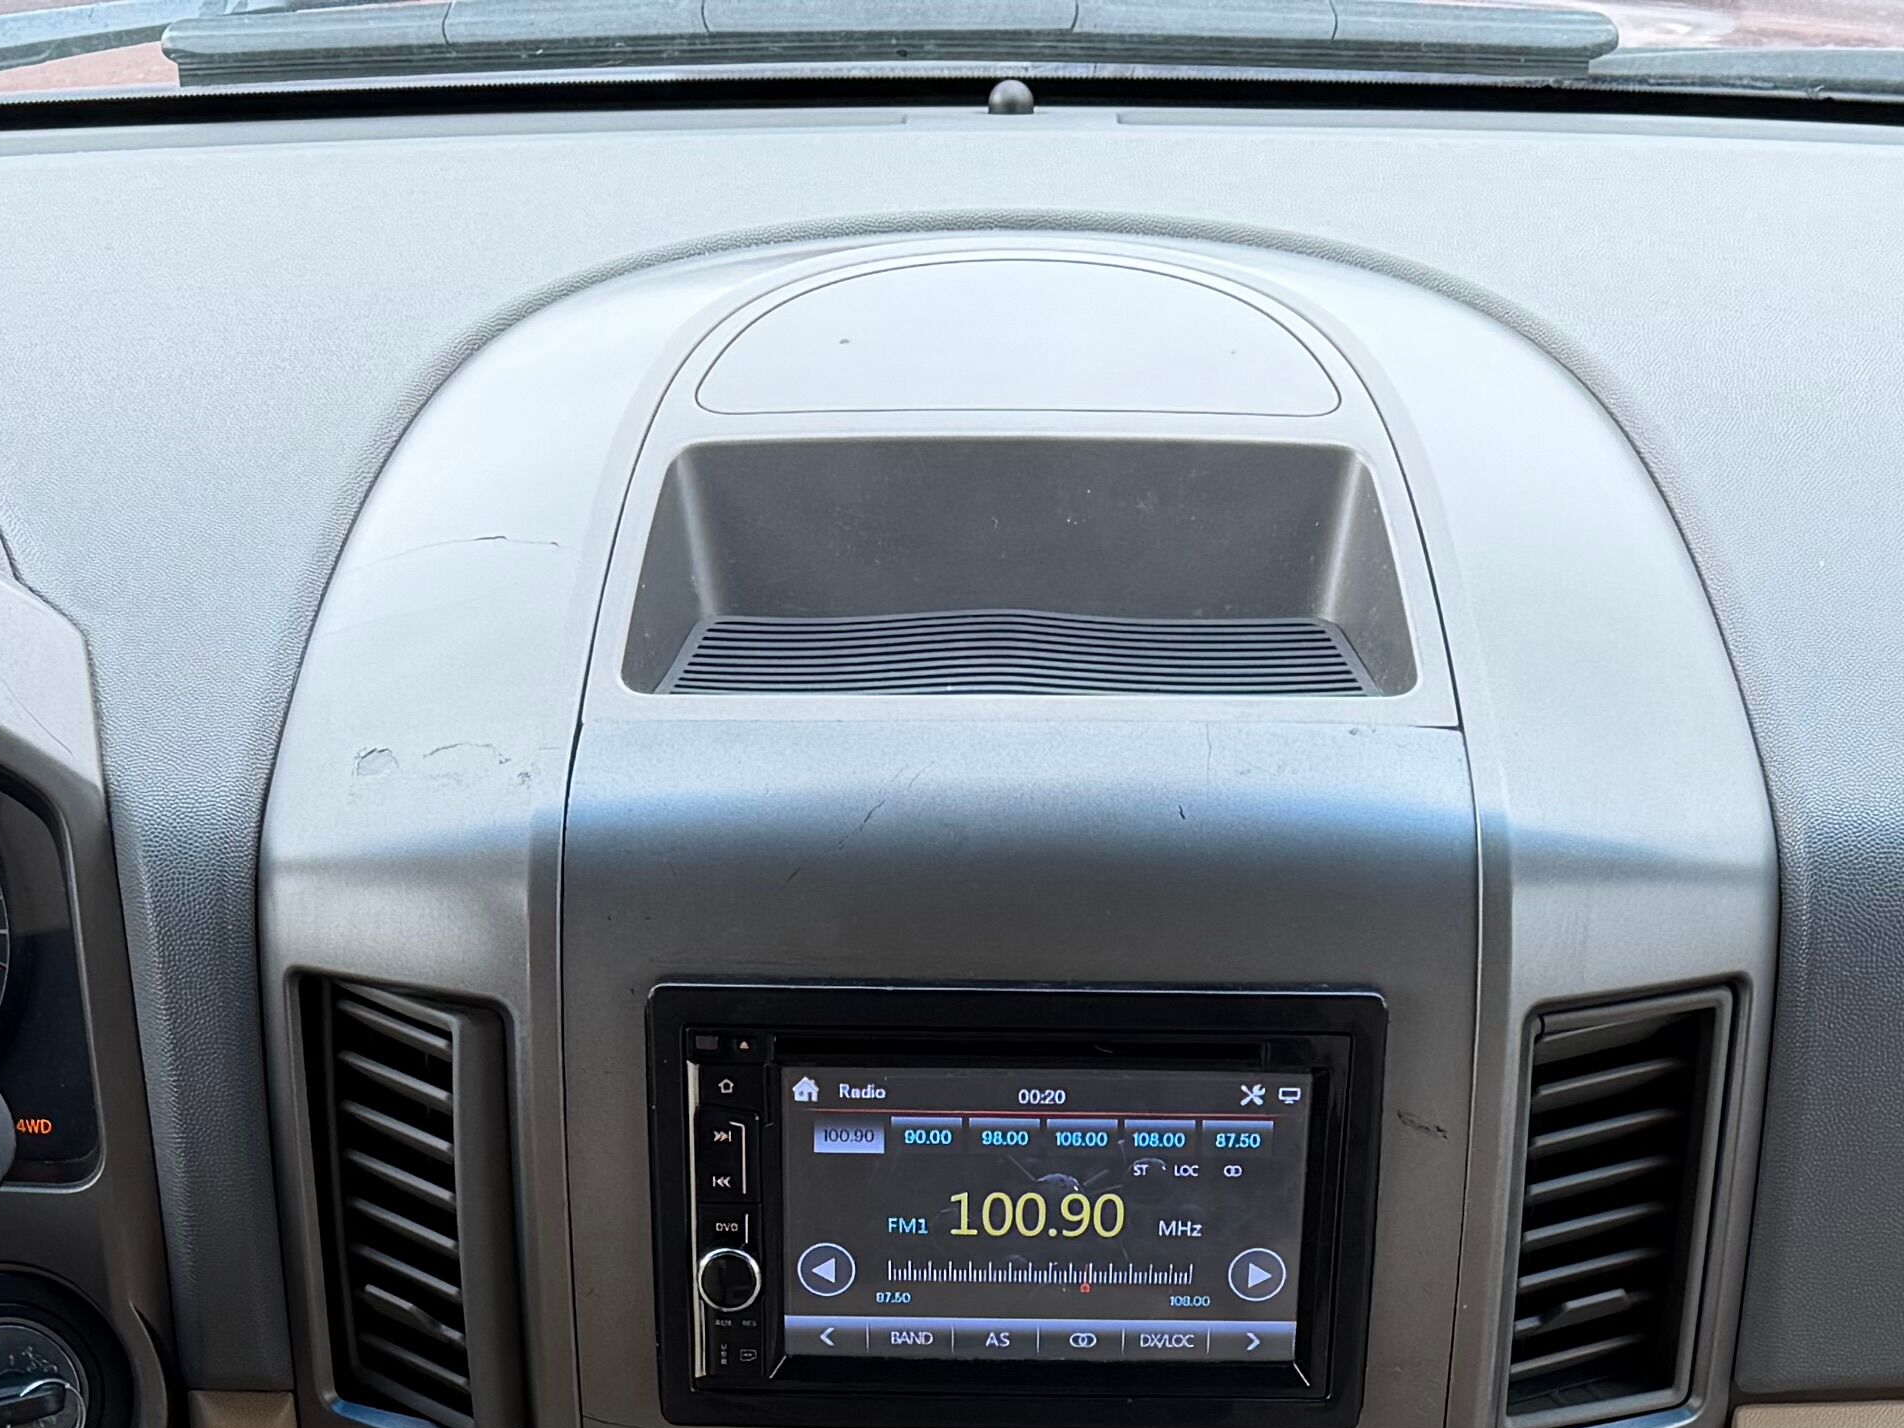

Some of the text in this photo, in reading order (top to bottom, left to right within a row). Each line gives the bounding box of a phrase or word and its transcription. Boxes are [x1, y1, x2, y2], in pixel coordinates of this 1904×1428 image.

[839, 1084, 887, 1100] Radio
[1018, 1090, 1066, 1105] 00:20
[15, 1118, 53, 1134] 4WD
[822, 1128, 1261, 1149] 100.90 90.00 98.00 106.00 108.00 87.50
[1133, 1164, 1199, 1178] ST LOC
[950, 1191, 1125, 1238] 100.90
[888, 1218, 928, 1234] FM1
[1158, 1220, 1203, 1237] MHz
[890, 1331, 1195, 1348] BAND AS DX/LOC
